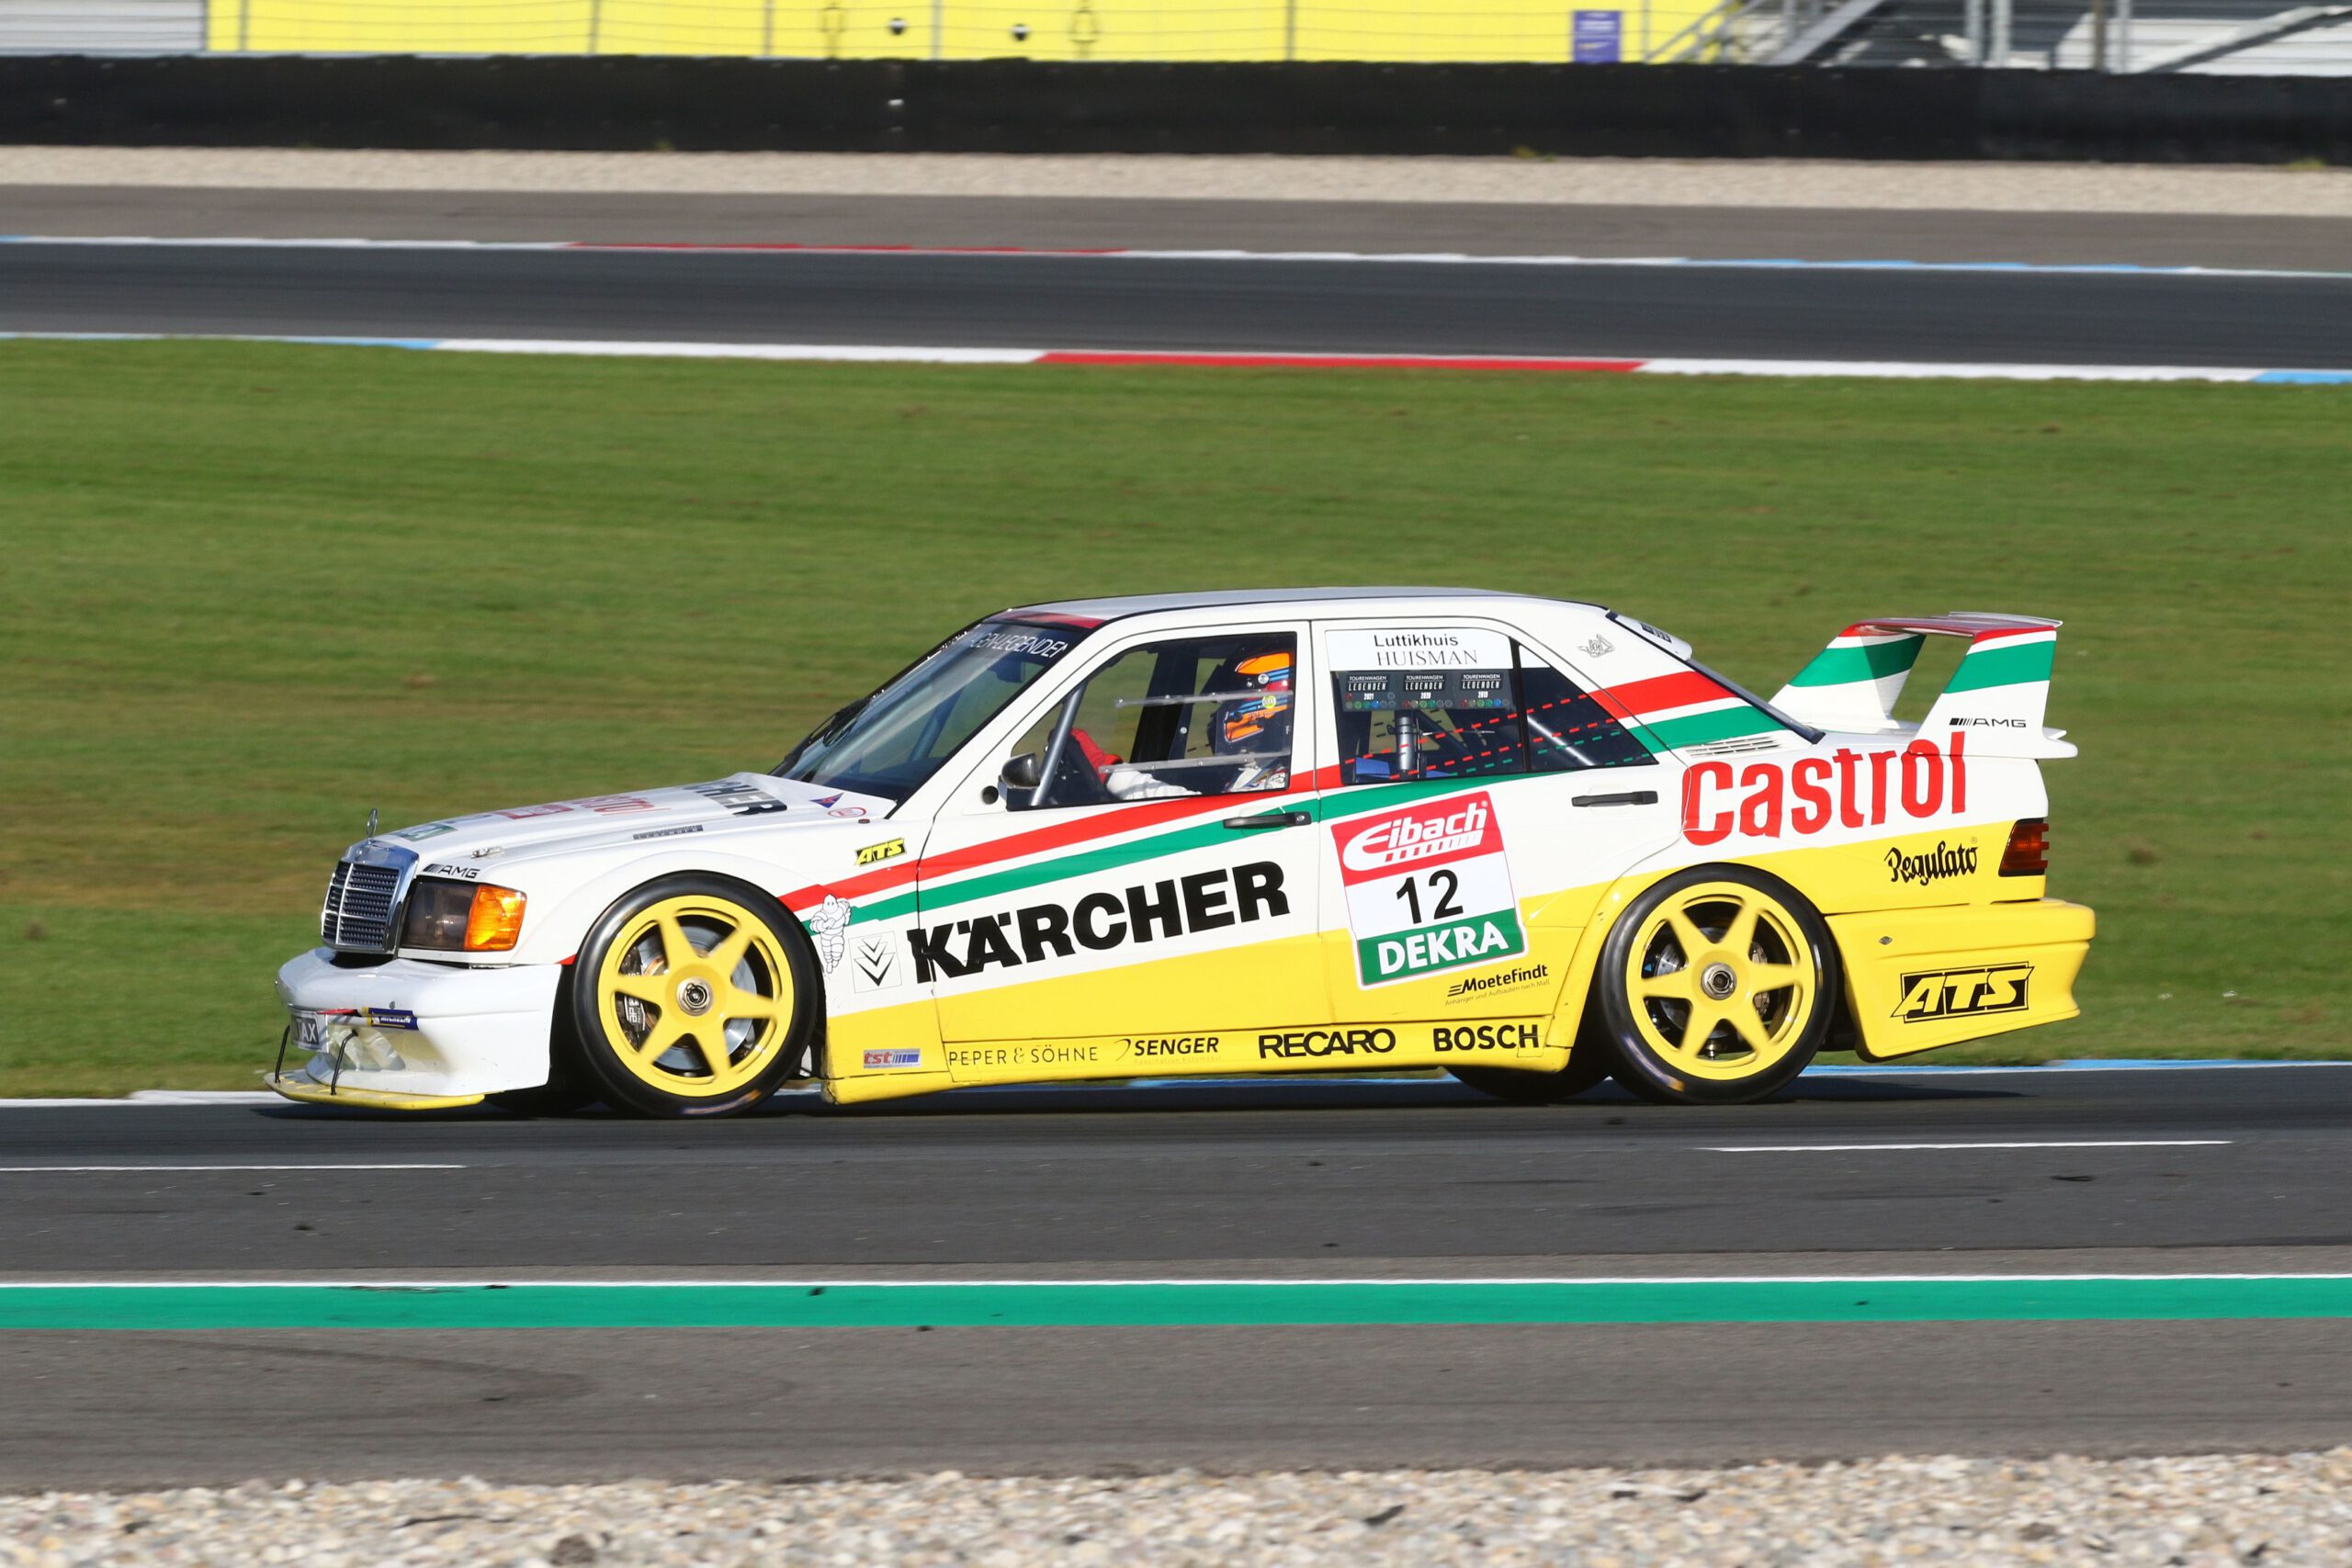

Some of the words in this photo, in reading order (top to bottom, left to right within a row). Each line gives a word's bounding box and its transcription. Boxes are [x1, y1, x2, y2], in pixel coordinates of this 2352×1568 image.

[1374, 633, 1459, 648] Luttikhuis
[1377, 649, 1478, 667] HUISMAN
[1348, 682, 1386, 691] LEGENDEN
[1406, 682, 1442, 690] LEGENDEN
[1462, 681, 1499, 689] LEGENDEN
[1973, 718, 2027, 728] AMG
[1682, 731, 1965, 846] Castrol
[1342, 802, 1487, 872] Eibach
[856, 839, 904, 865] ATS
[1883, 840, 1978, 886] Regulato
[438, 864, 481, 879] AMG
[1396, 869, 1464, 924] 12
[907, 861, 1291, 984] KÄRCHER
[1378, 920, 1509, 975] DEKRA
[1462, 964, 1549, 994] Moetefindt
[1890, 964, 2035, 1019] ATS
[1135, 1037, 1219, 1056] SENGER
[1258, 1028, 1396, 1058] RECARO
[1433, 1024, 1539, 1052] BOSCH
[865, 1052, 892, 1064] tst
[949, 1049, 1008, 1066] PEPER
[1013, 1047, 1025, 1064] &
[1031, 1043, 1099, 1064] SÖHNE
